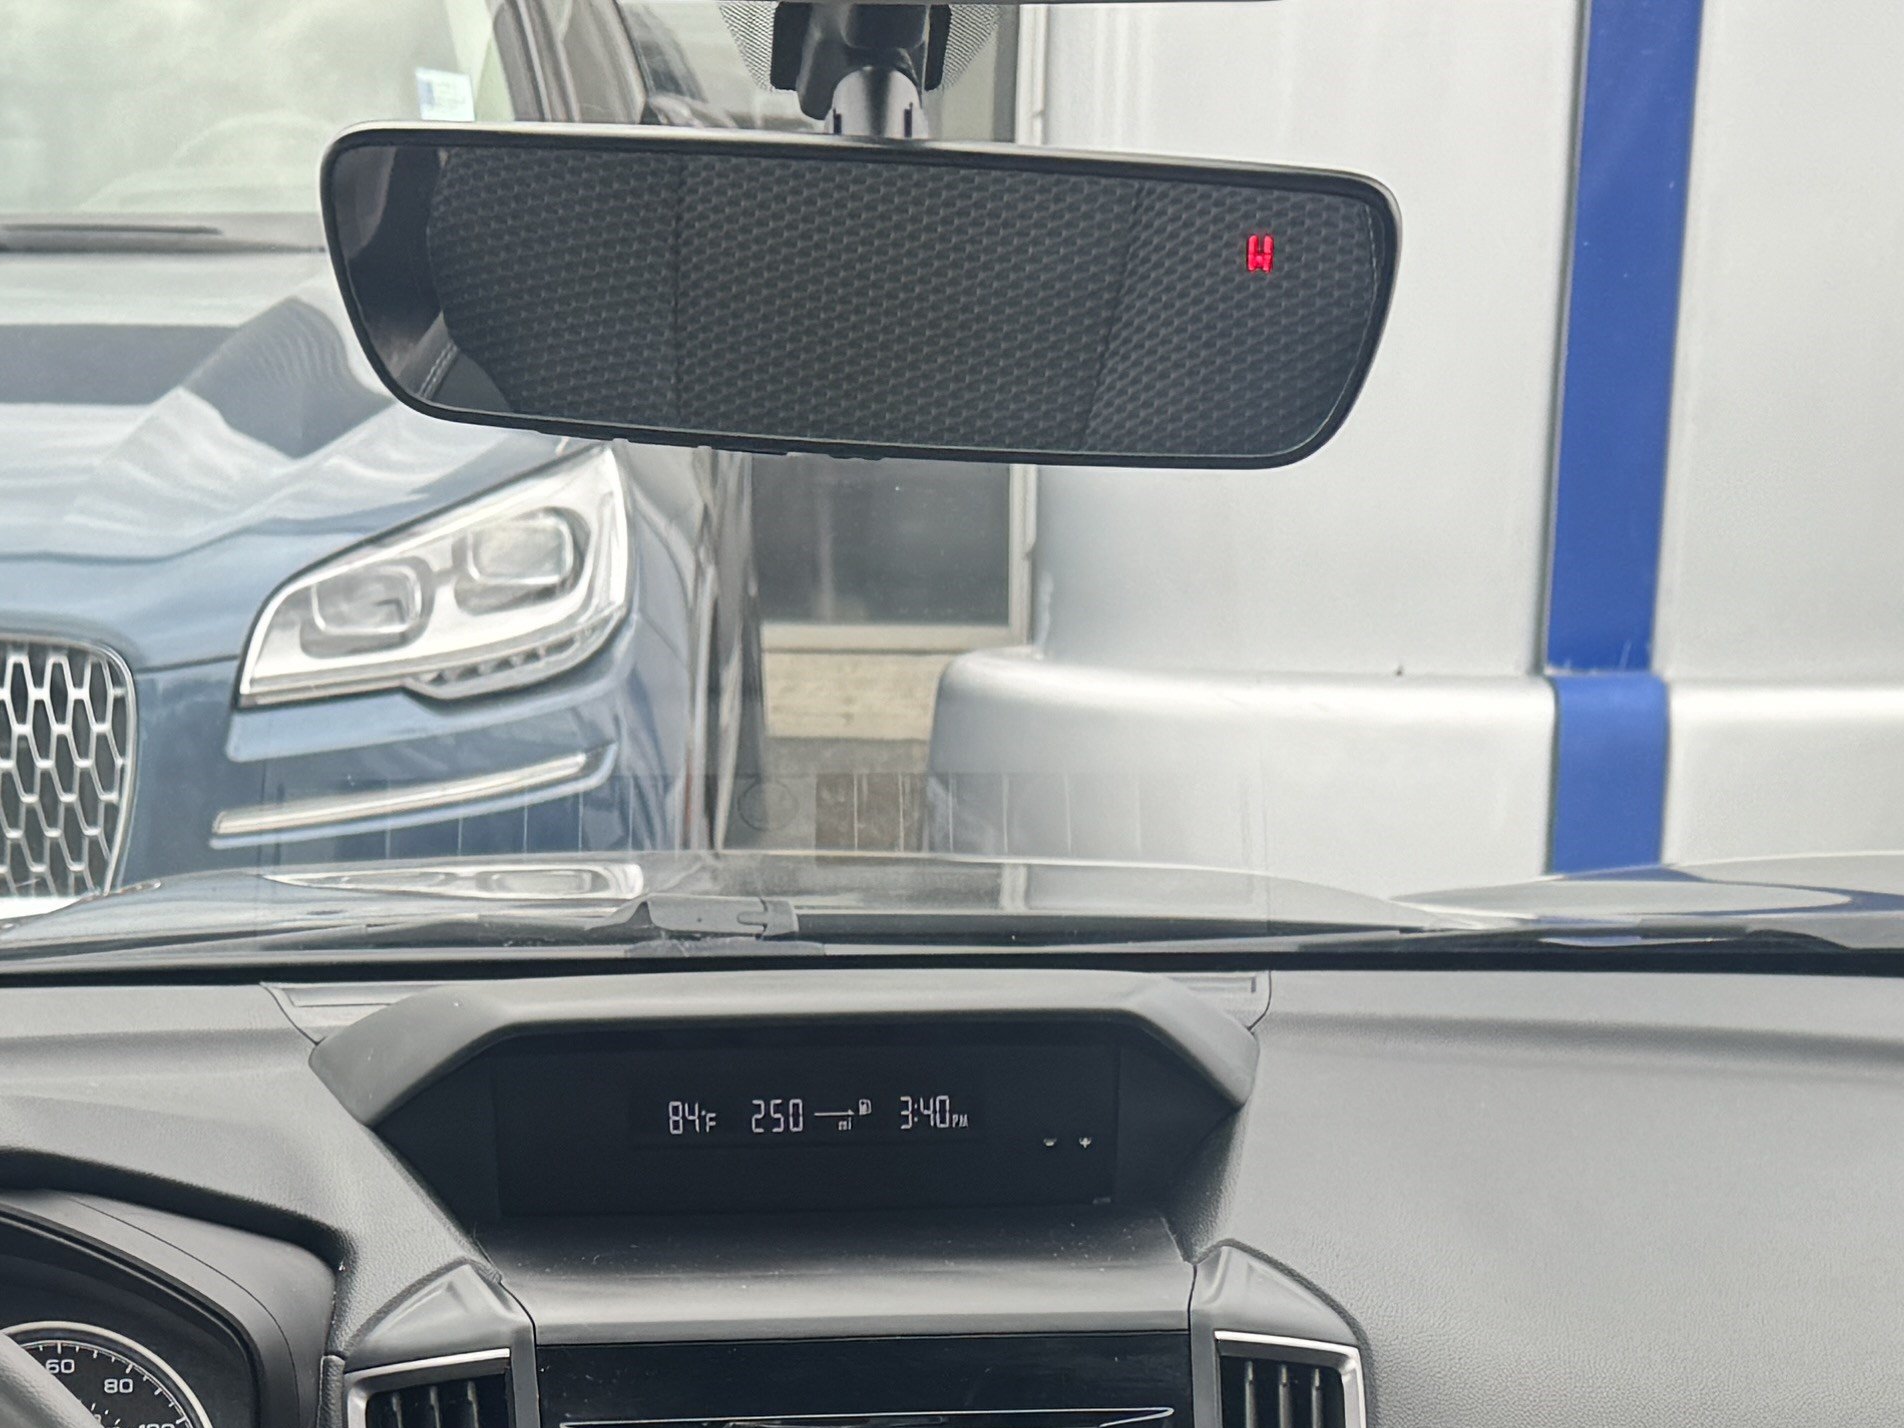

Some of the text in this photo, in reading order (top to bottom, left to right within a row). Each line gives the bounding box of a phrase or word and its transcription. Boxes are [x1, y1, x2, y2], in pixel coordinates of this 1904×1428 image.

[751, 1098, 804, 1134] 250
[45, 1358, 76, 1375] 60
[103, 1377, 134, 1394] 80
